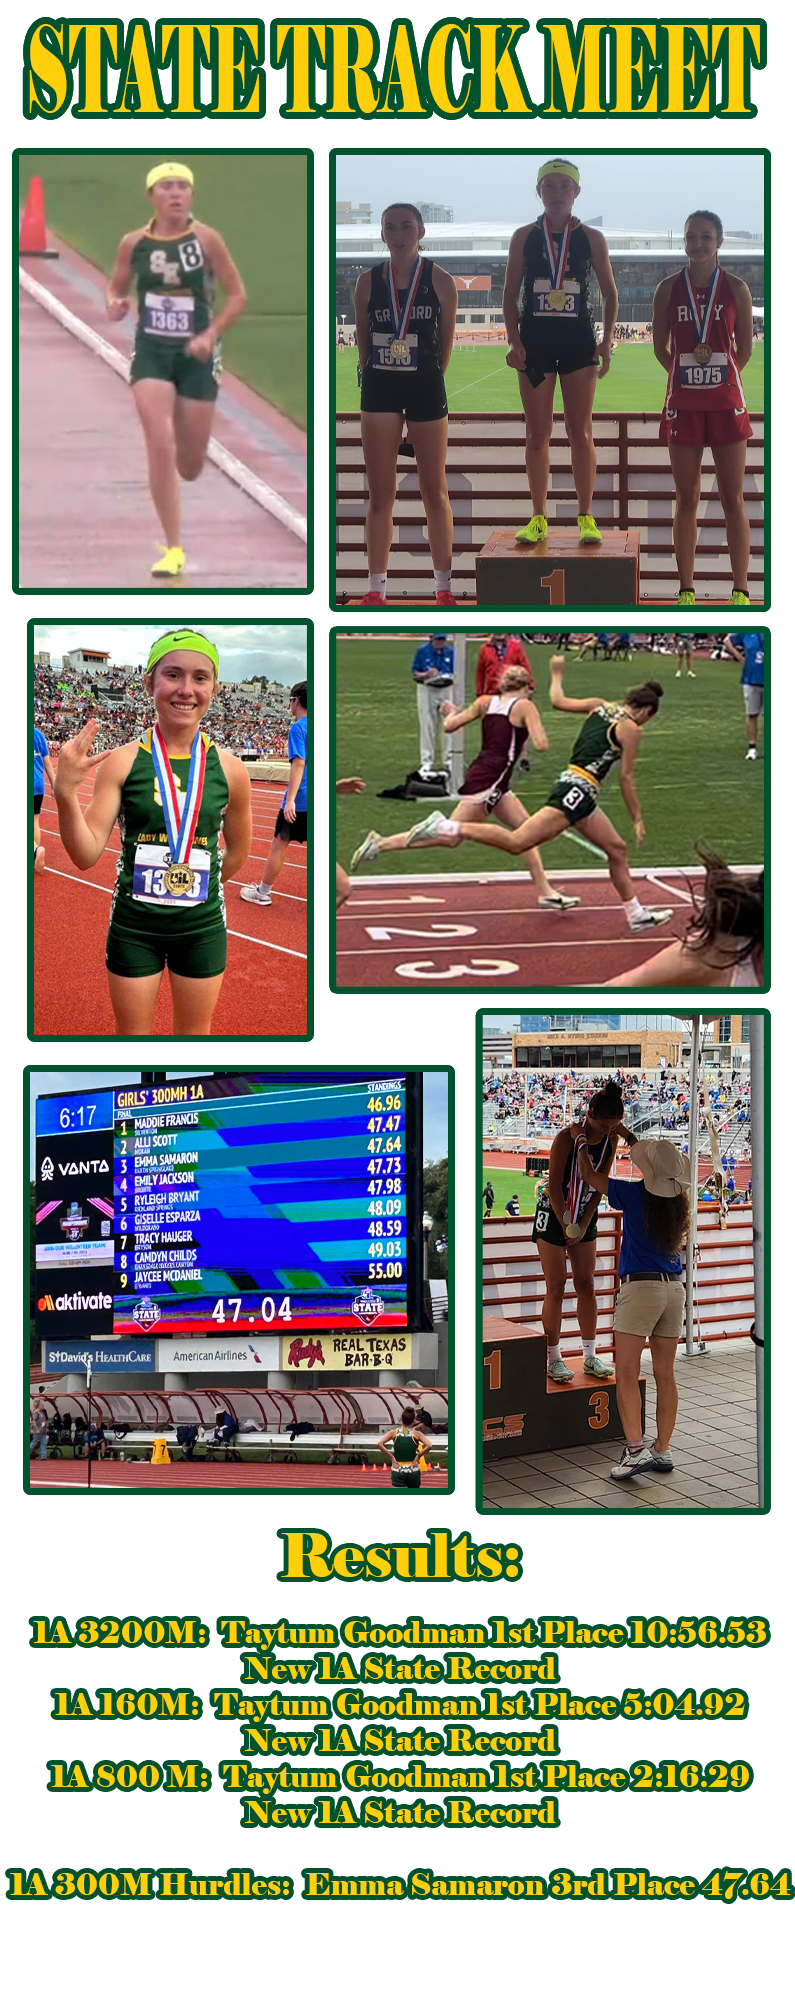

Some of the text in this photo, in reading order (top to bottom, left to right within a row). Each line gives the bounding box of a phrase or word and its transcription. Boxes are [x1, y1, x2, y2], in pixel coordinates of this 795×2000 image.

[182, 242, 200, 267] 8
[151, 310, 188, 331] 1363
[685, 367, 722, 384] 1975
[540, 569, 566, 605] 1
[566, 790, 581, 805] 3
[137, 833, 156, 842] LADY
[142, 868, 202, 898] 133
[364, 924, 479, 940] 2
[395, 959, 520, 979] 3
[117, 1084, 204, 1107] GIRLS' 300MH 1A
[367, 1081, 401, 1093] STANDINGS
[367, 1094, 401, 1112] 46.96
[60, 1105, 97, 1128] 6:17
[121, 1112, 199, 1135] 1 MADDIE FRANCIS
[367, 1115, 401, 1133] 47.47
[120, 1134, 178, 1154] 2 ALLI SCOTT
[367, 1136, 402, 1154] 47.64
[58, 1159, 109, 1176] VANTA
[120, 1152, 198, 1173] 3 EMMA SAMARON
[367, 1157, 401, 1175] 47.73
[120, 1178, 128, 1192] 4
[134, 1174, 158, 1187] EMILY
[159, 1172, 194, 1185] JACKSON
[367, 1178, 401, 1195] 47.98
[120, 1190, 200, 1212] 5 RYLEIGH BRYANT
[367, 1199, 401, 1216] 48.09
[120, 1210, 201, 1231] 6 GISELLE ESPARZA
[367, 1220, 402, 1237] 48.59
[120, 1230, 193, 1250] 7 TRACY HAUGER
[367, 1241, 402, 1258] 49.03
[120, 1255, 128, 1269] 8
[134, 1250, 168, 1263] CAMDYN
[169, 1249, 197, 1261] CHILDS
[120, 1269, 203, 1288] 9 JAYCEE MCDANIEL
[368, 1261, 403, 1279] 55.00
[55, 1291, 113, 1311] aktivate
[211, 1296, 292, 1323] 47.04
[353, 1302, 384, 1312] STATE
[133, 1310, 160, 1319] STATE
[288, 1338, 325, 1369] Rudy's
[333, 1338, 364, 1352] REAL
[173, 1350, 247, 1362] American Airlines
[345, 1353, 393, 1367] BAR-B-Q
[483, 1349, 501, 1390] 1
[588, 1391, 610, 1430] 3
